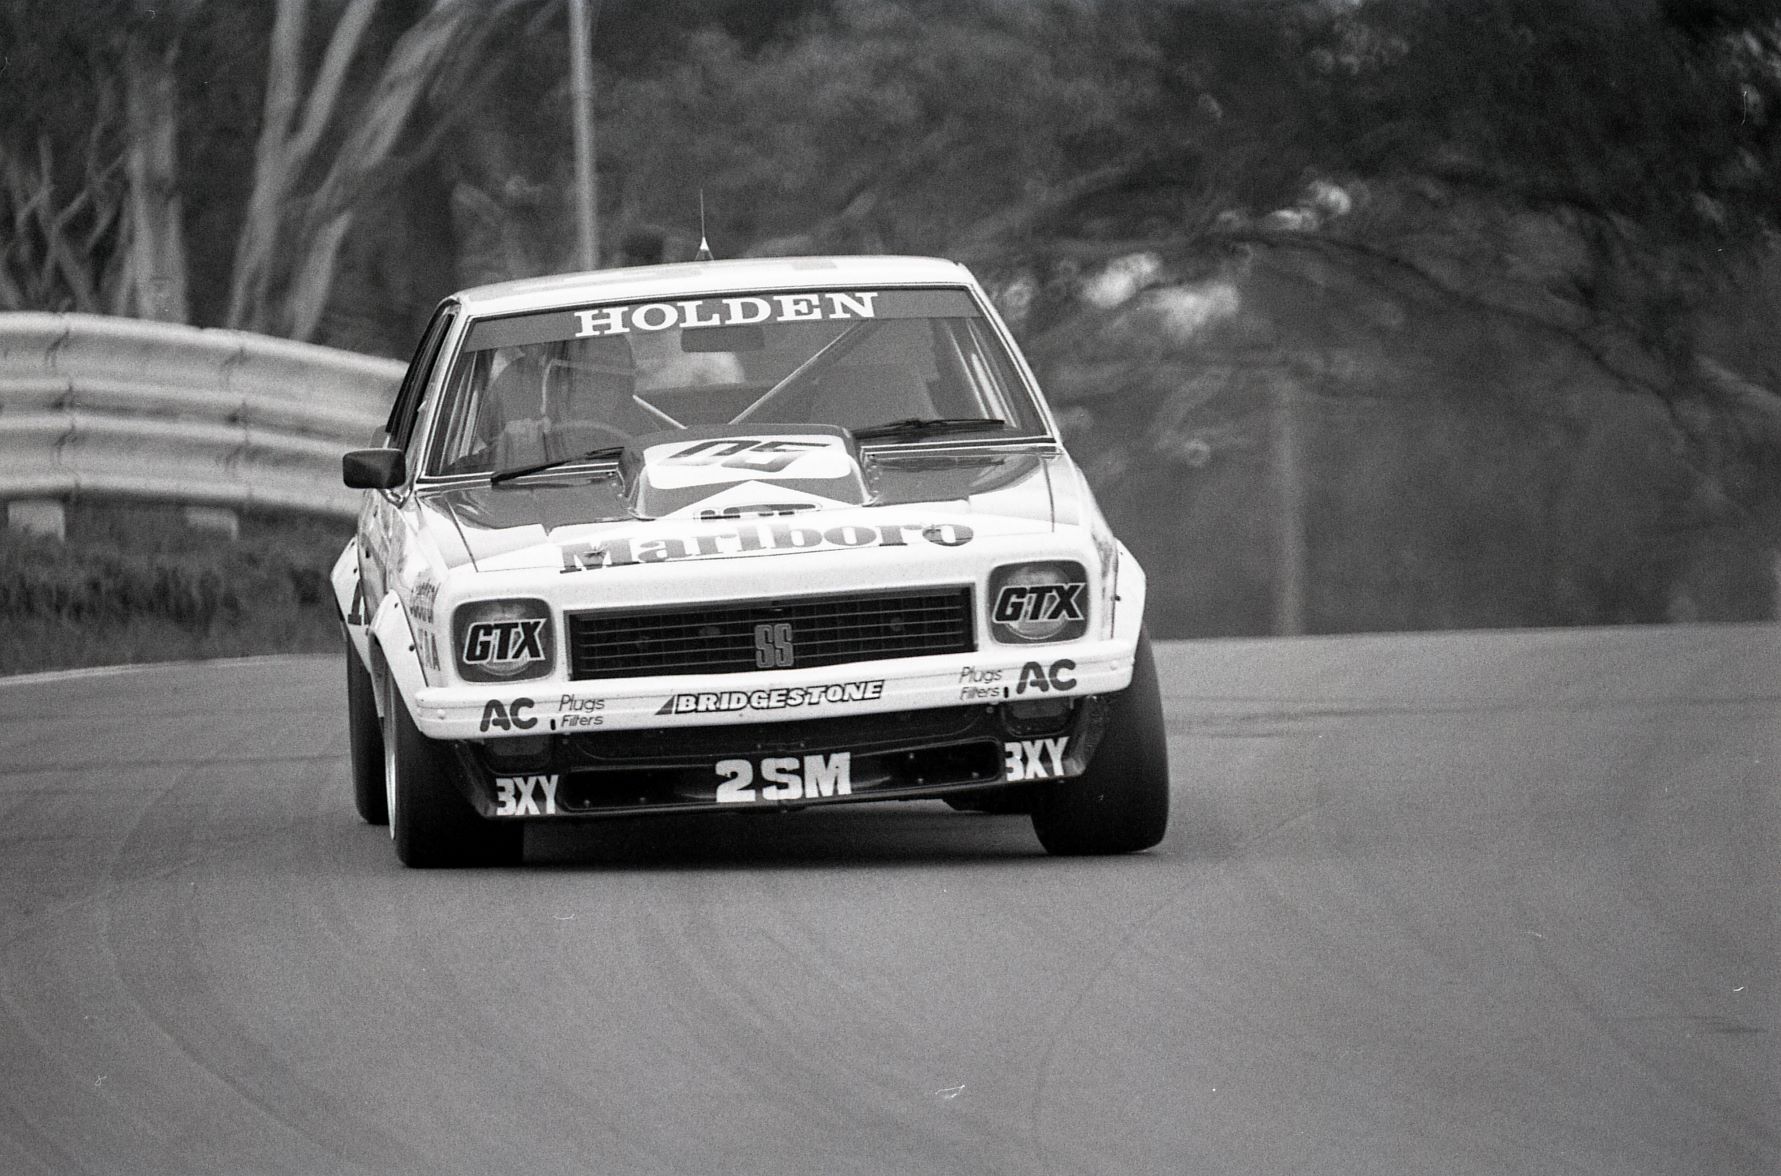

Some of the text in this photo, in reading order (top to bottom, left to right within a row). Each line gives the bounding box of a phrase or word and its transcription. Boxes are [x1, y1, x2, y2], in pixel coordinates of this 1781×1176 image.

[574, 292, 878, 337] HOLDEN
[560, 523, 975, 574] Marlboro
[992, 582, 1087, 624] GTX
[463, 618, 547, 664] GTX
[755, 623, 794, 668] SS
[958, 666, 1002, 684] Plugs
[1016, 659, 1078, 695] AC
[559, 694, 605, 714] Plugs
[674, 680, 885, 714] BRIDGESTONE
[959, 686, 1000, 701] Filters
[480, 697, 538, 732] AC
[560, 714, 604, 728] Filters
[715, 752, 852, 803] 2SM
